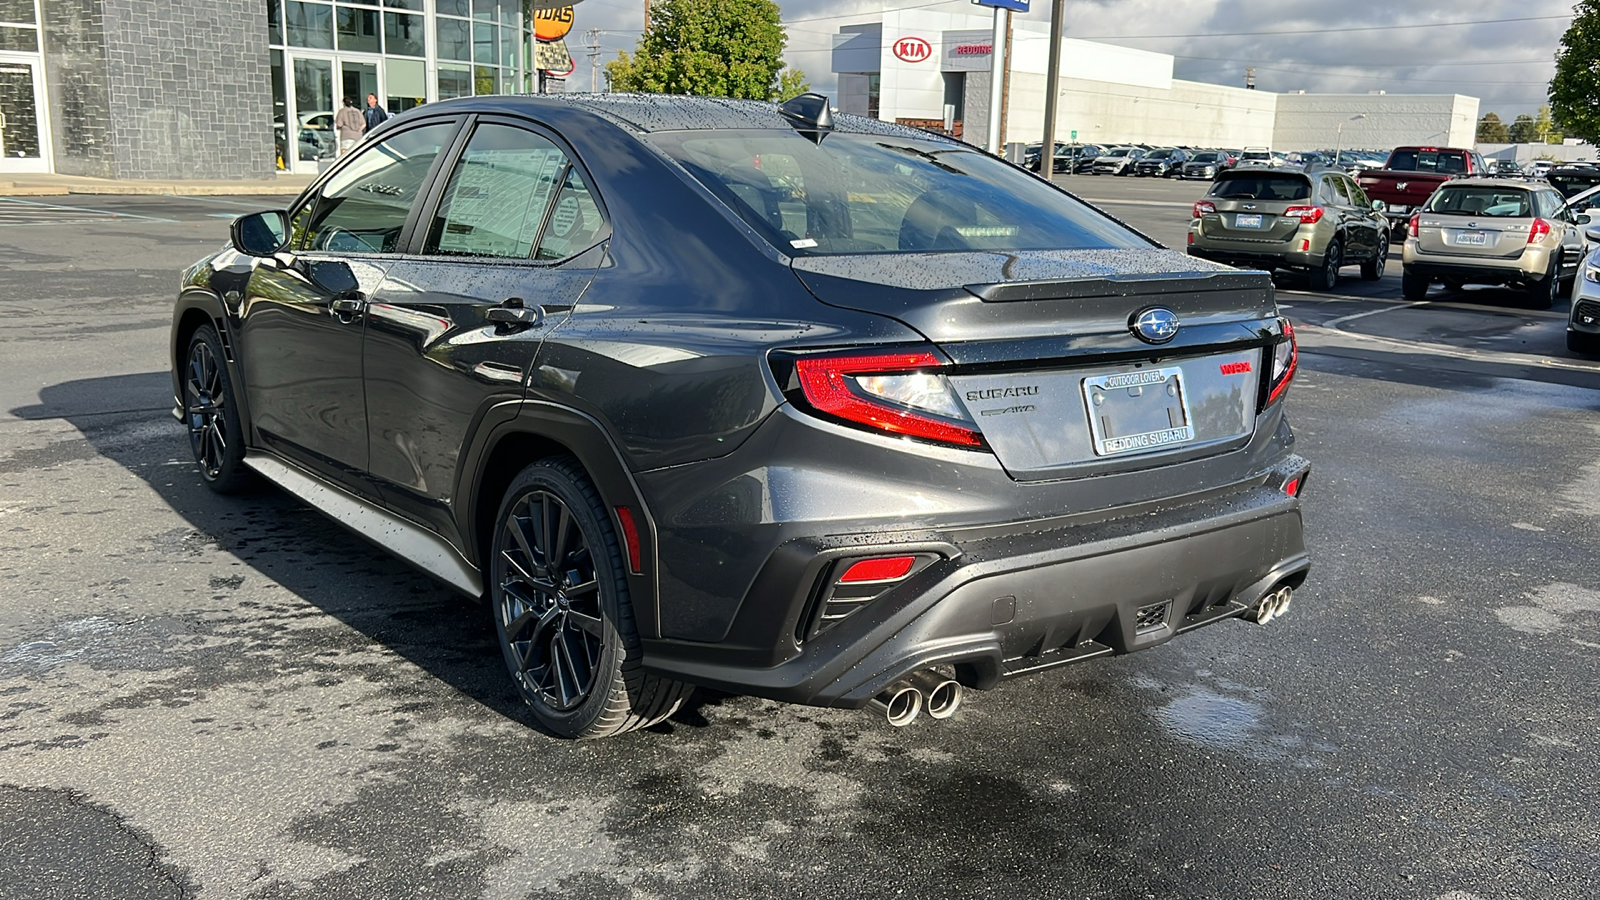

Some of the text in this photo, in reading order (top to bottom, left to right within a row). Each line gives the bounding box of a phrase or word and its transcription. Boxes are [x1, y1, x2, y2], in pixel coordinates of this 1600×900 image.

[900, 42, 926, 58] KIA
[957, 45, 993, 55] REDDING
[1219, 361, 1252, 376] WRX
[1109, 371, 1160, 387] OUTDOOR LOVER
[966, 385, 1039, 402] SUBARU
[1105, 429, 1187, 452] REDDING SUBARU
